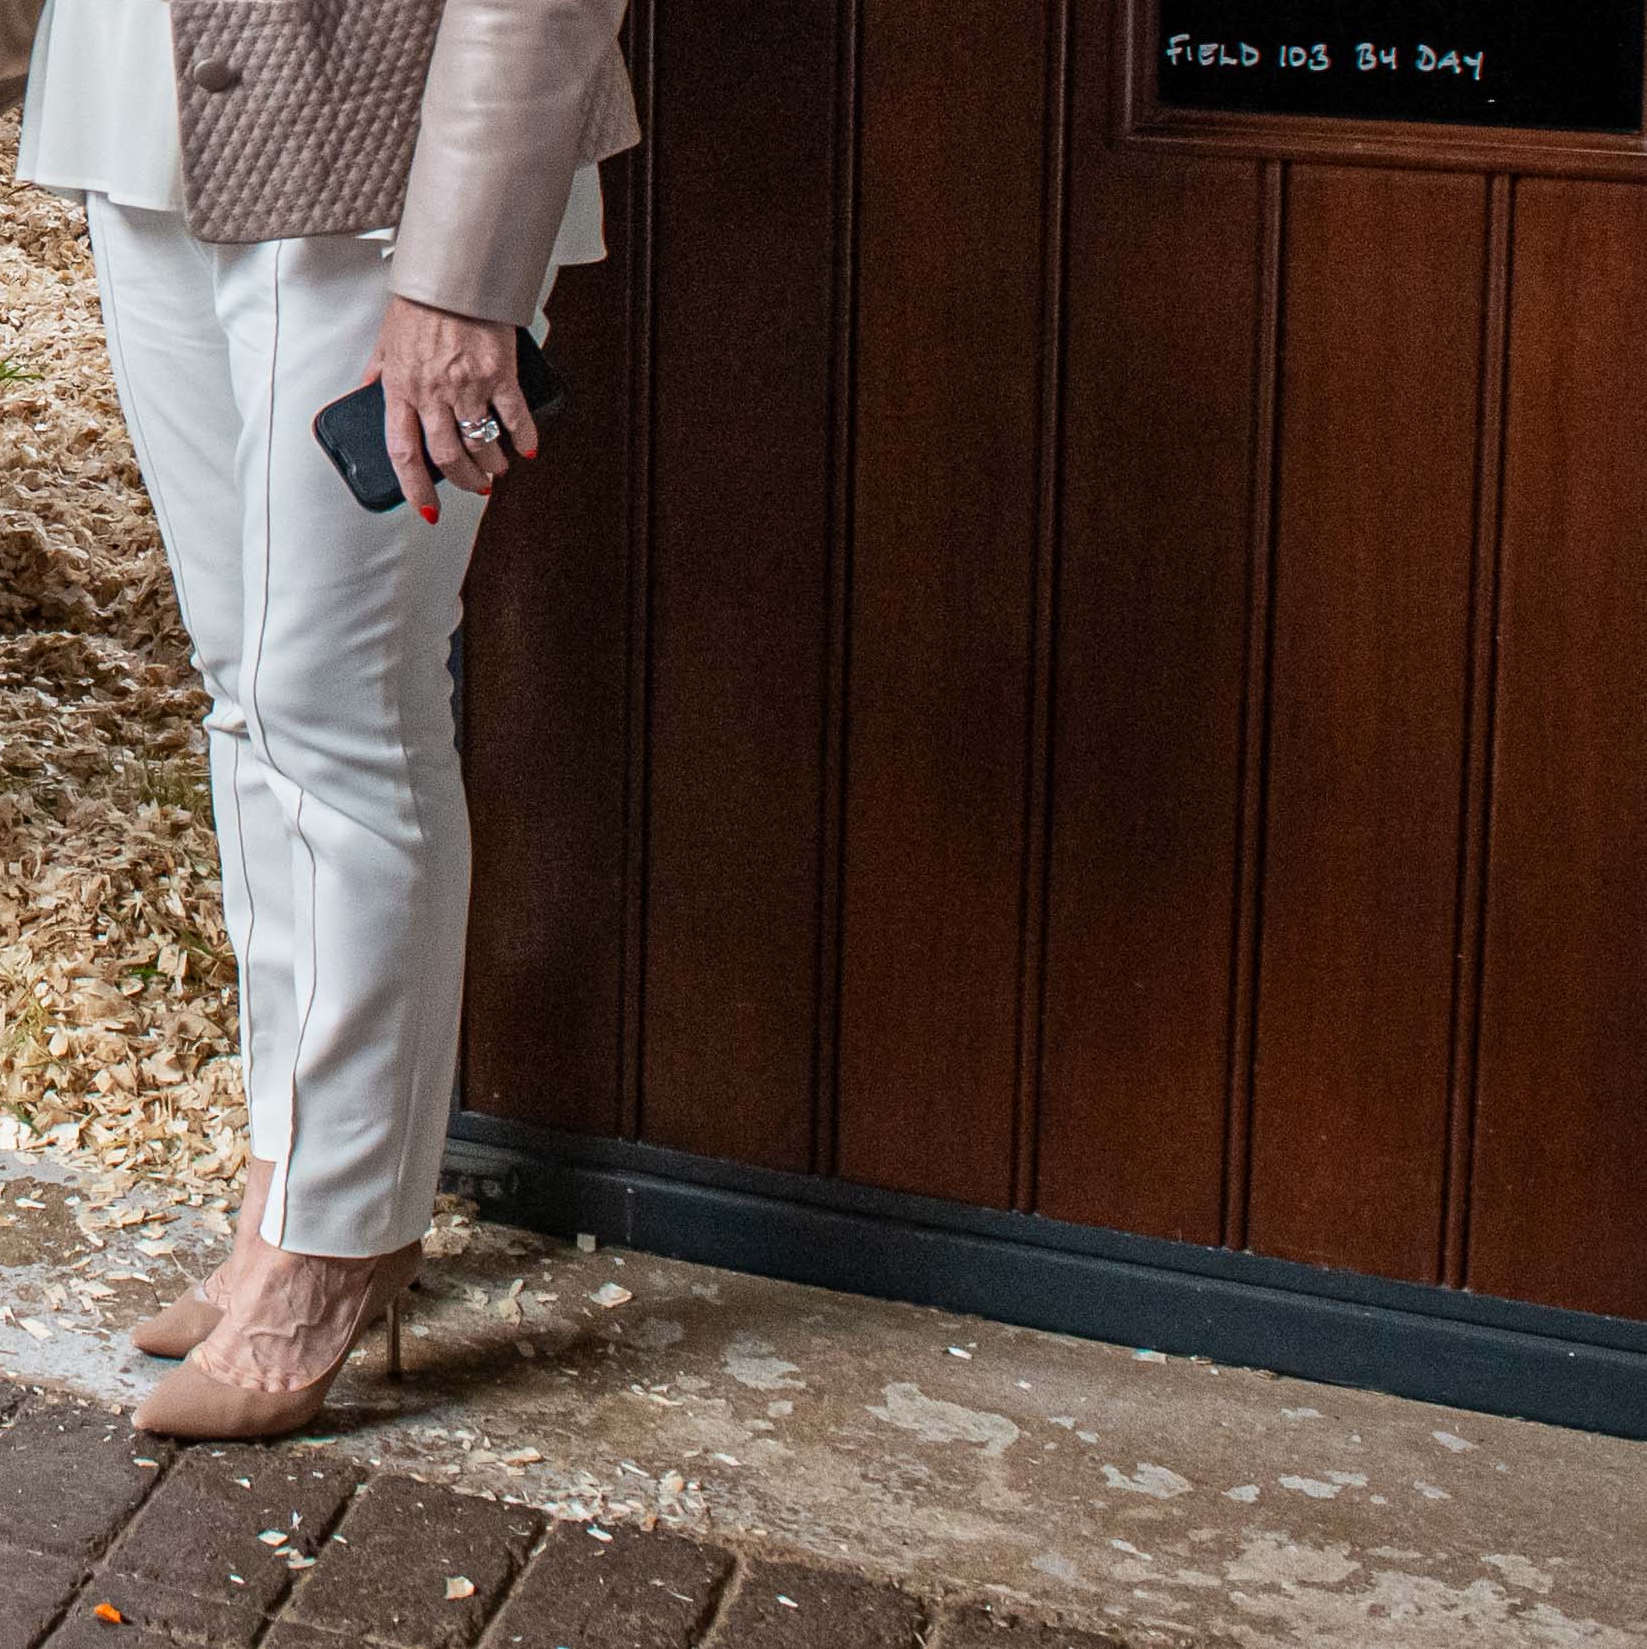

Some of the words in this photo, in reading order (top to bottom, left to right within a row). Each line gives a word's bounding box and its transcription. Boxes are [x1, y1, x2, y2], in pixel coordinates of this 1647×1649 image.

[1165, 33, 1260, 68] FIELD
[1279, 42, 1331, 71] 103
[1415, 45, 1485, 80] DAY
